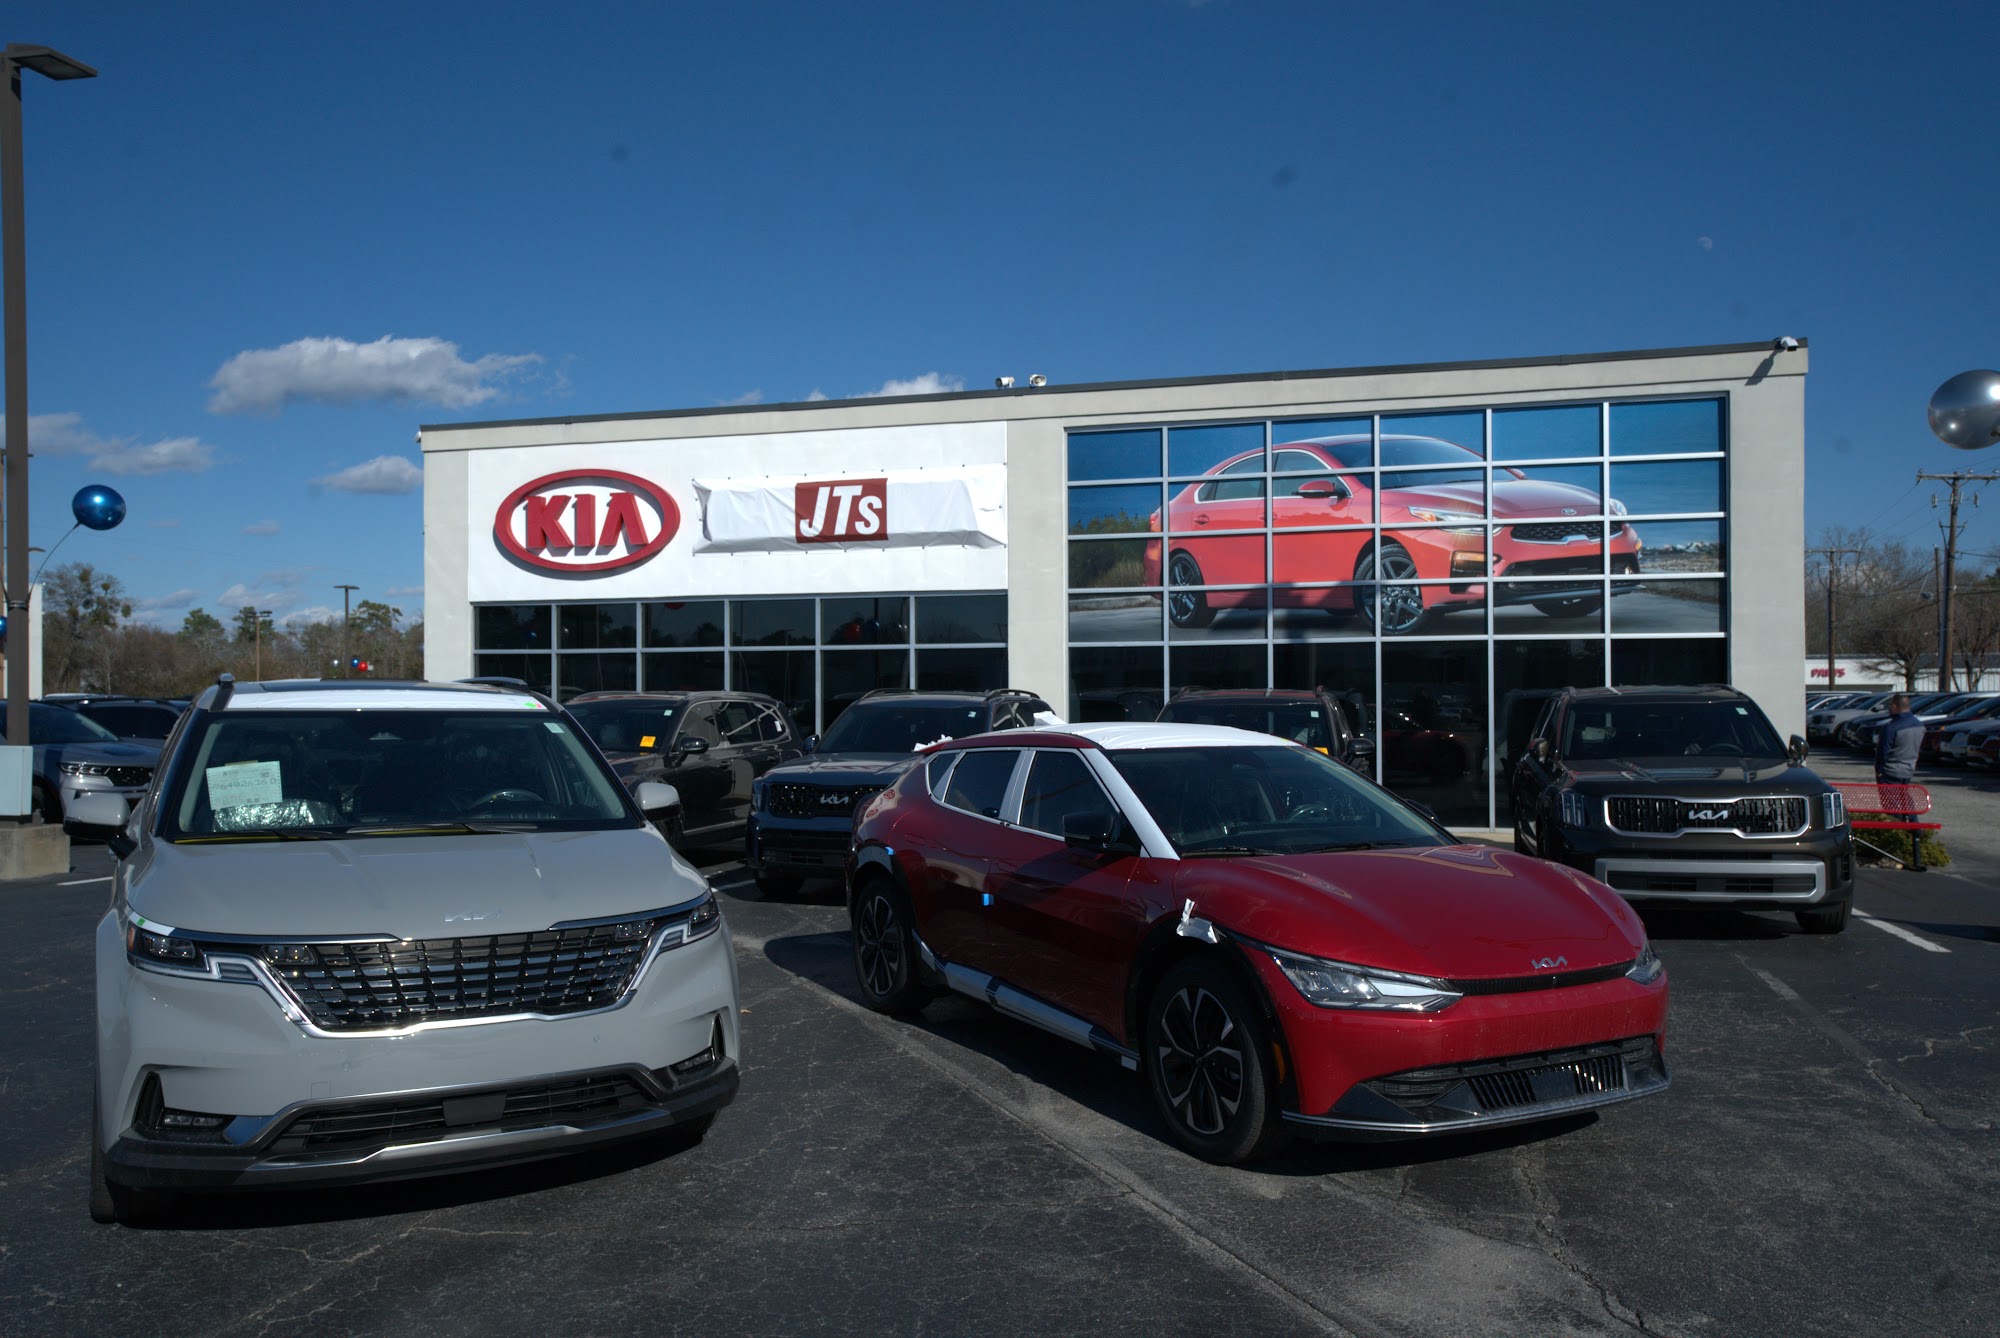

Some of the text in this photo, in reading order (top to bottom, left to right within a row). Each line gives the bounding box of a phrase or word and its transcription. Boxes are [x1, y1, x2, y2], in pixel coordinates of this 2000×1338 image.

[799, 484, 882, 538] JTs
[524, 491, 649, 549] KIA
[820, 794, 849, 804] KIA
[1688, 809, 1729, 821] KIA
[1531, 955, 1568, 969] KIA
